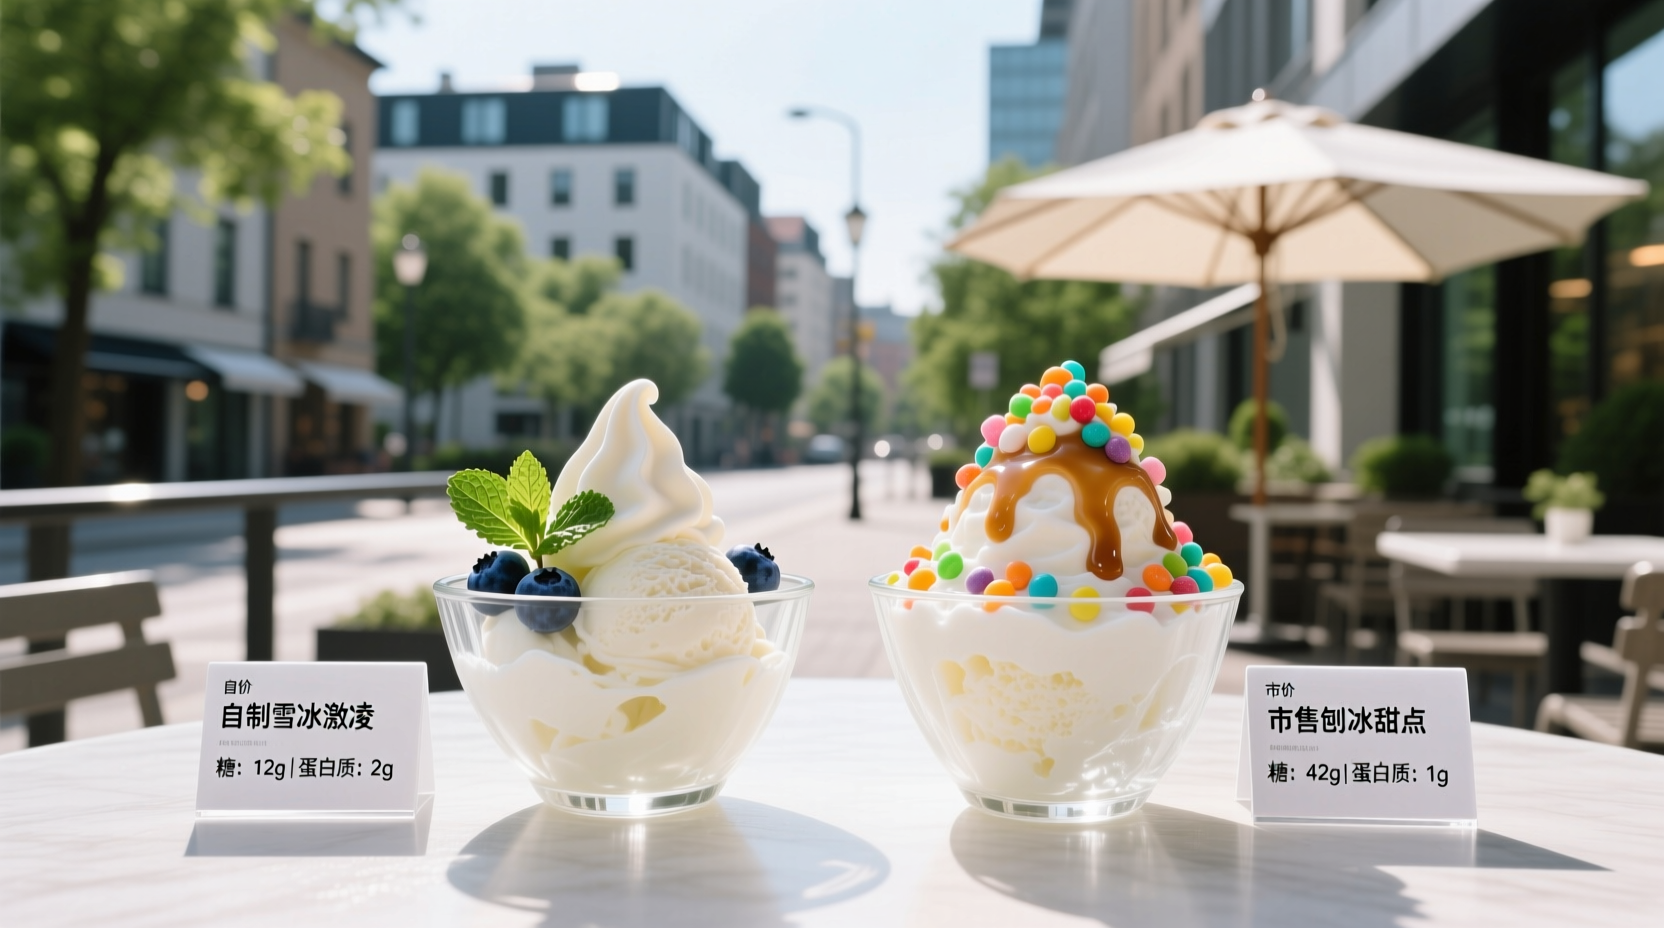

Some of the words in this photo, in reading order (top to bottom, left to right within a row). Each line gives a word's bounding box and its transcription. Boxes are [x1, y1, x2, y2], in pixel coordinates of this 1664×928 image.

[224, 678, 252, 695] 自价
[1264, 681, 1295, 698] 市价
[221, 701, 375, 731] 自制雪冰激凌
[1267, 705, 1427, 735] 市售刨冰甜点
